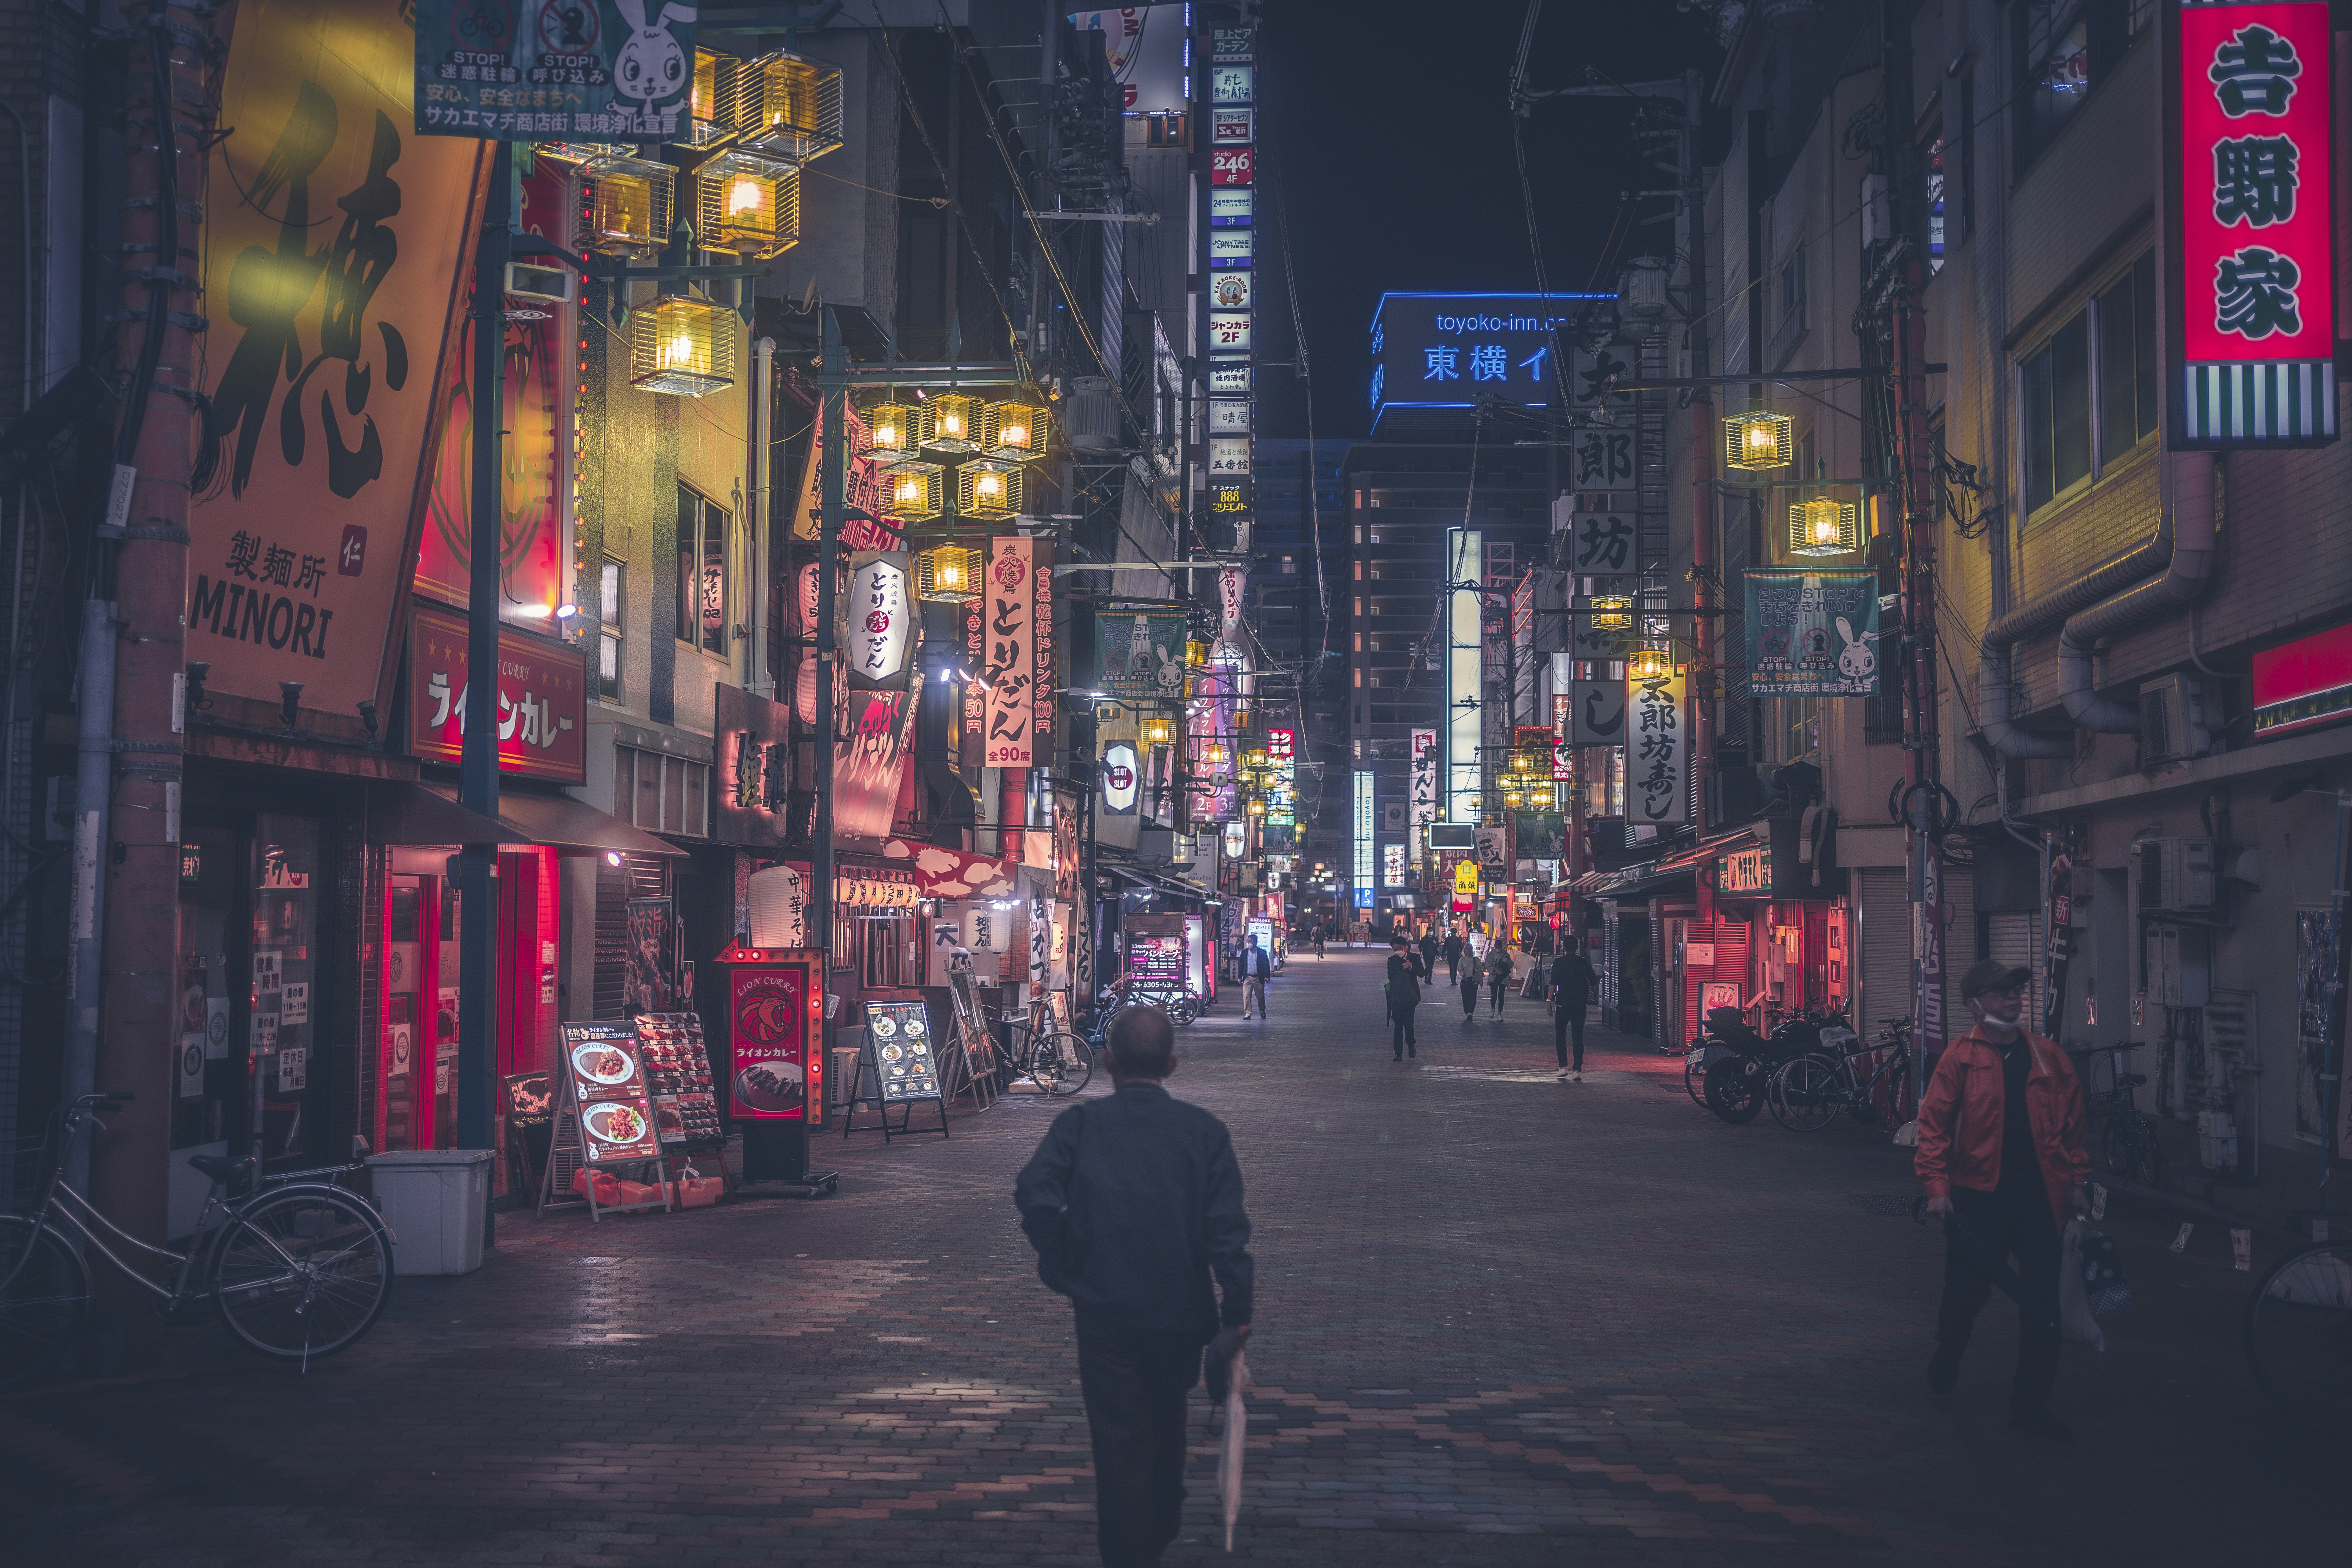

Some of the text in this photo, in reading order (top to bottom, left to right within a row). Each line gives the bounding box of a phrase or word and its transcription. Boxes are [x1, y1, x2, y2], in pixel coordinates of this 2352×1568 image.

[1214, 28, 1252, 40] 屋上ビア
[1216, 41, 1249, 52] ガーデン
[454, 52, 505, 66] STOP!
[544, 55, 595, 68] STOP!
[441, 64, 516, 82] 迷惑駐輪
[532, 69, 604, 85] 呼び込み
[426, 84, 583, 107] 安心、安全なまちへ
[425, 106, 677, 134] サカエマチ商店街 環境浄化宣言
[1214, 153, 1250, 173] 246
[1227, 175, 1237, 183] 4F
[1211, 321, 1250, 330] ジャンカラ
[1437, 313, 1567, 334] toyoko-inn.c
[1221, 332, 1239, 343] 2F
[1223, 411, 1248, 423] 晴屋
[1212, 459, 1248, 470] 五番館
[1220, 491, 1240, 502] 888
[1002, 544, 1017, 595] 炭火焼鳥
[890, 573, 898, 606] 炭火焼鳥
[1759, 600, 1855, 613] まちをきれいに
[189, 574, 333, 660] MINORI
[1105, 633, 1171, 642] まちをきれいに
[503, 661, 530, 681] CURRY
[989, 598, 1031, 742] とりだん
[1751, 672, 1825, 681] 安心、安全なまちへ
[1145, 689, 1179, 698] 環境浄化宣言
[1752, 682, 1872, 693] サカエマチ商店街 環境浄化宣言
[988, 747, 1031, 762] 全90席
[1114, 768, 1127, 776] SLOT
[1197, 797, 1211, 810] 2F
[1220, 797, 1234, 811] 3F
[1390, 857, 1398, 884] 中野屋
[1365, 889, 1370, 898] P
[787, 873, 803, 948] 中華そば
[2056, 899, 2068, 924] 新
[975, 916, 987, 947] おでん
[256, 956, 274, 973] 営業
[262, 973, 279, 990] 時間
[737, 976, 798, 997] LION CURRY
[287, 987, 303, 998] 昼の部
[257, 1017, 275, 1028] 夜の部
[567, 1028, 581, 1038] 名物
[578, 1044, 591, 1053] LION
[737, 1048, 797, 1057] ライオンカレー
[283, 1051, 303, 1065] 定休日
[1689, 1053, 1703, 1063] 21-16
[588, 1105, 599, 1115] LION
